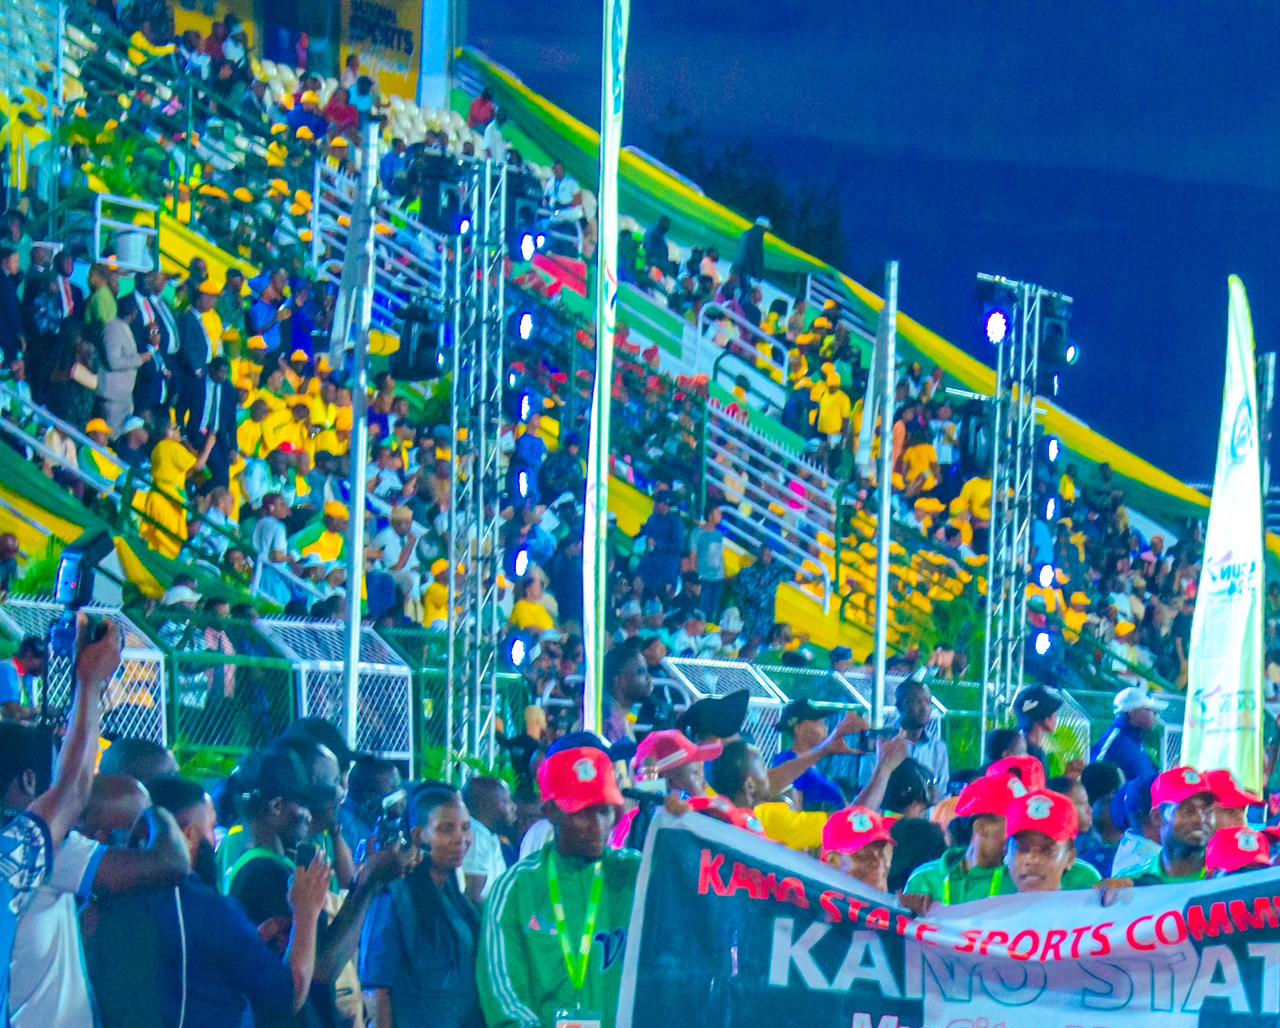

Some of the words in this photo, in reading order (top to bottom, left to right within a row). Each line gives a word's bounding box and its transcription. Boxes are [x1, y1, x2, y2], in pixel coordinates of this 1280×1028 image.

[698, 849, 811, 909] KANO
[820, 891, 940, 947] STATE
[953, 922, 1114, 962] SPORTS
[769, 917, 1048, 1006] KANO
